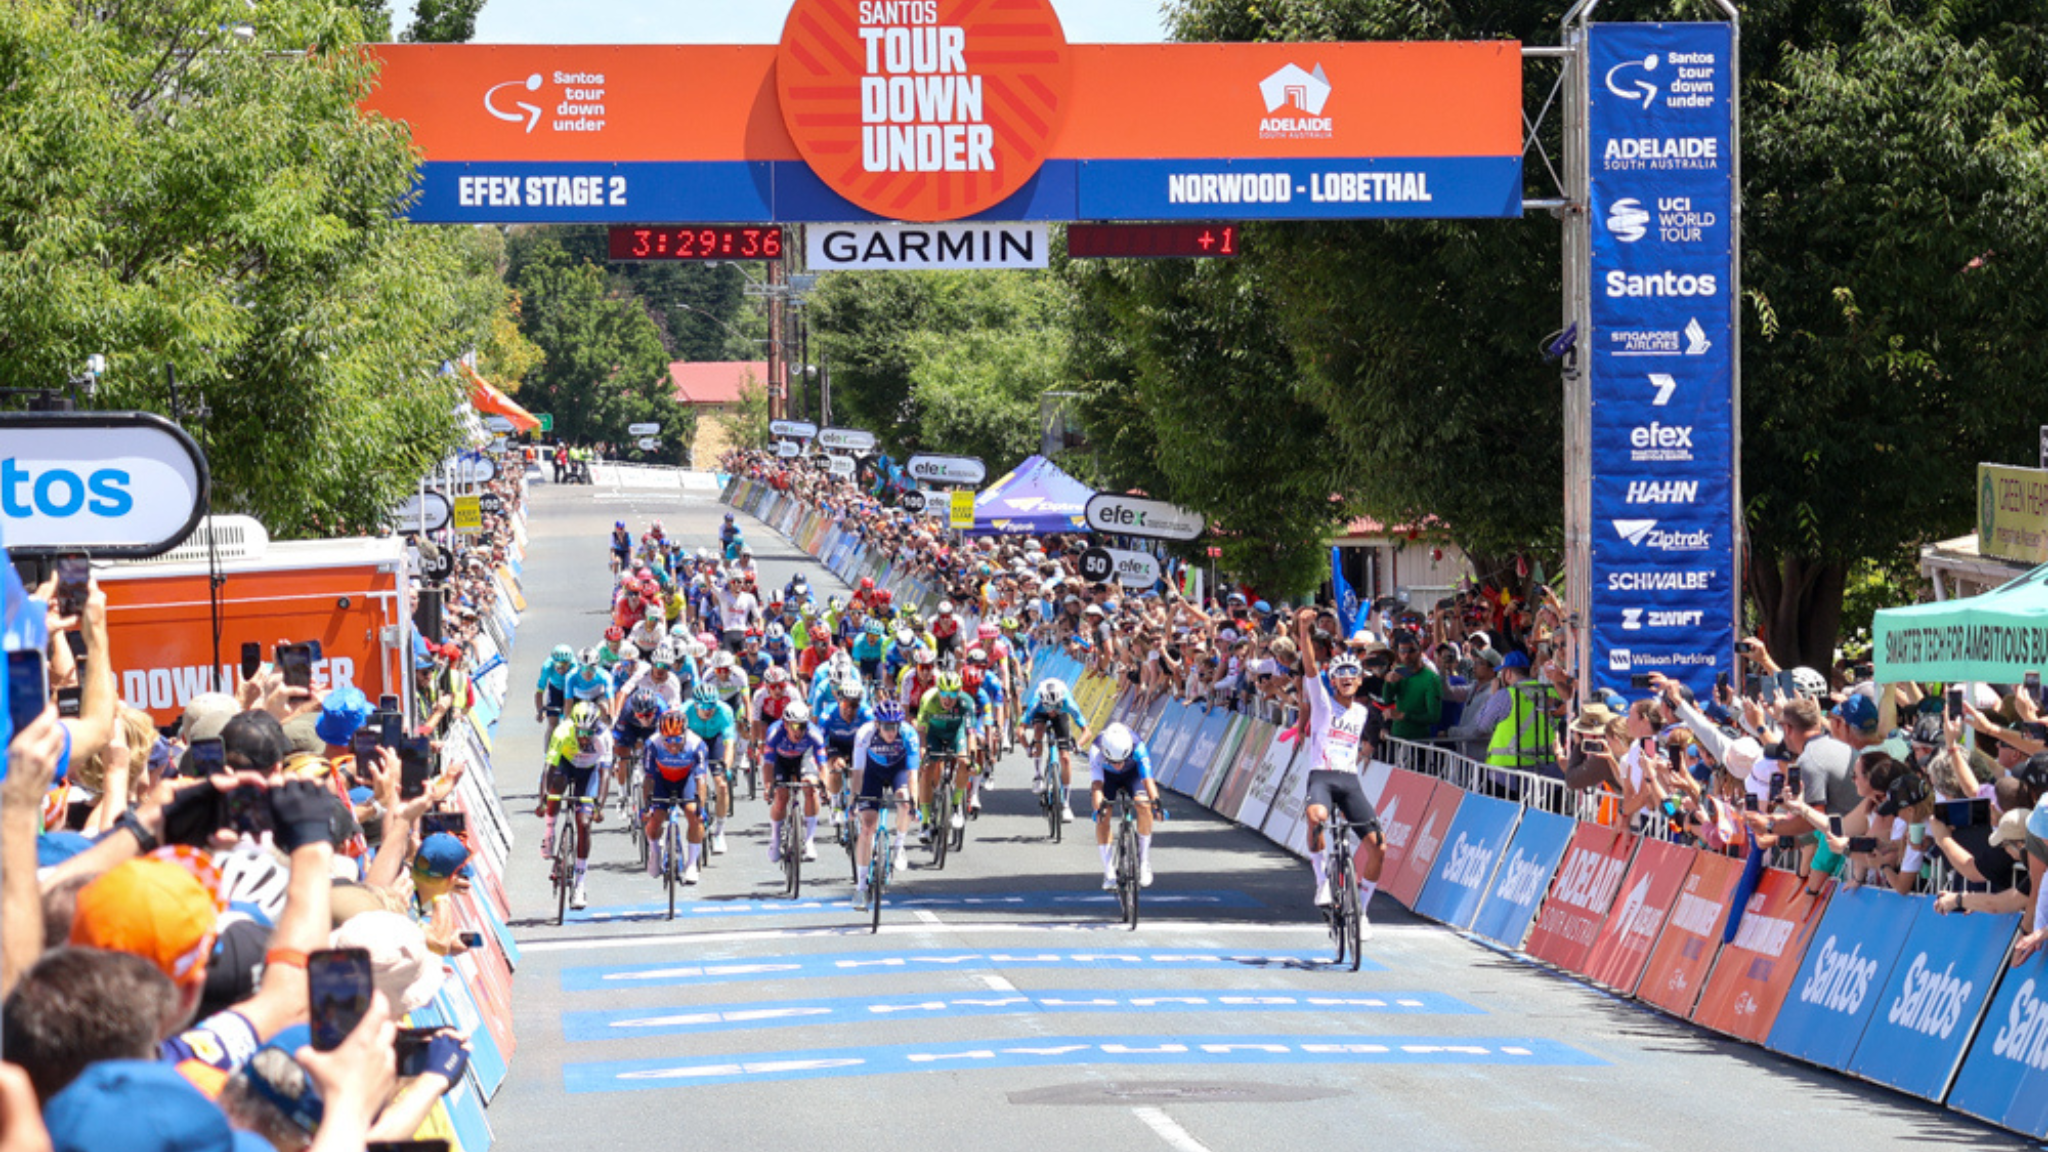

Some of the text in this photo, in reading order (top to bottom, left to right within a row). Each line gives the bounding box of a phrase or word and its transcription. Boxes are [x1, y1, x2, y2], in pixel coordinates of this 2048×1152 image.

[859, 0, 937, 24] SANTOS
[858, 26, 967, 74] TOUR
[1668, 52, 1715, 64] Santos
[553, 71, 605, 85] Santos
[1678, 66, 1715, 78] tour
[565, 87, 605, 100] tour
[1670, 79, 1714, 92] down
[557, 100, 605, 115] down
[861, 75, 983, 123] DOWN
[1667, 93, 1715, 107] under
[553, 116, 606, 131] under
[1259, 118, 1333, 131] ADELAIDE
[862, 124, 995, 172] UNDER
[1604, 138, 1718, 159] ADELAIDE
[1604, 159, 1718, 170] SOUTH AUSTRALIA
[459, 177, 627, 206] EFEX STAGE 2
[1168, 172, 1289, 203] NORWOOD
[1311, 171, 1431, 202] LOBETHAL
[1658, 198, 1690, 211] UCI
[1658, 213, 1715, 227] WORLD
[632, 229, 780, 256] 3:29:36
[1197, 228, 1233, 255] +1
[1658, 227, 1702, 242] TOUR
[822, 230, 1034, 264] GARMIN
[1606, 270, 1717, 297] Santos
[1630, 421, 1693, 448] efex
[915, 462, 947, 476] efex
[1, 456, 133, 518] tos
[1626, 481, 1698, 503] HAHN
[1100, 505, 1147, 526] efex
[1646, 530, 1710, 551] Ziptrak
[1086, 556, 1150, 574] 50 efex
[1608, 573, 1709, 590] SCHWALBE
[1647, 610, 1704, 627] ZWIFT
[1886, 629, 1922, 664] SMARTER
[1964, 624, 2029, 664] AMBITIOUS
[1631, 653, 1716, 667] Wilson Parking
[123, 663, 233, 710] DOWN
[1442, 831, 1493, 889] Santos
[1497, 847, 1546, 906] Santos
[1802, 935, 1877, 1015] Santos
[1888, 952, 1972, 1040] Santos
